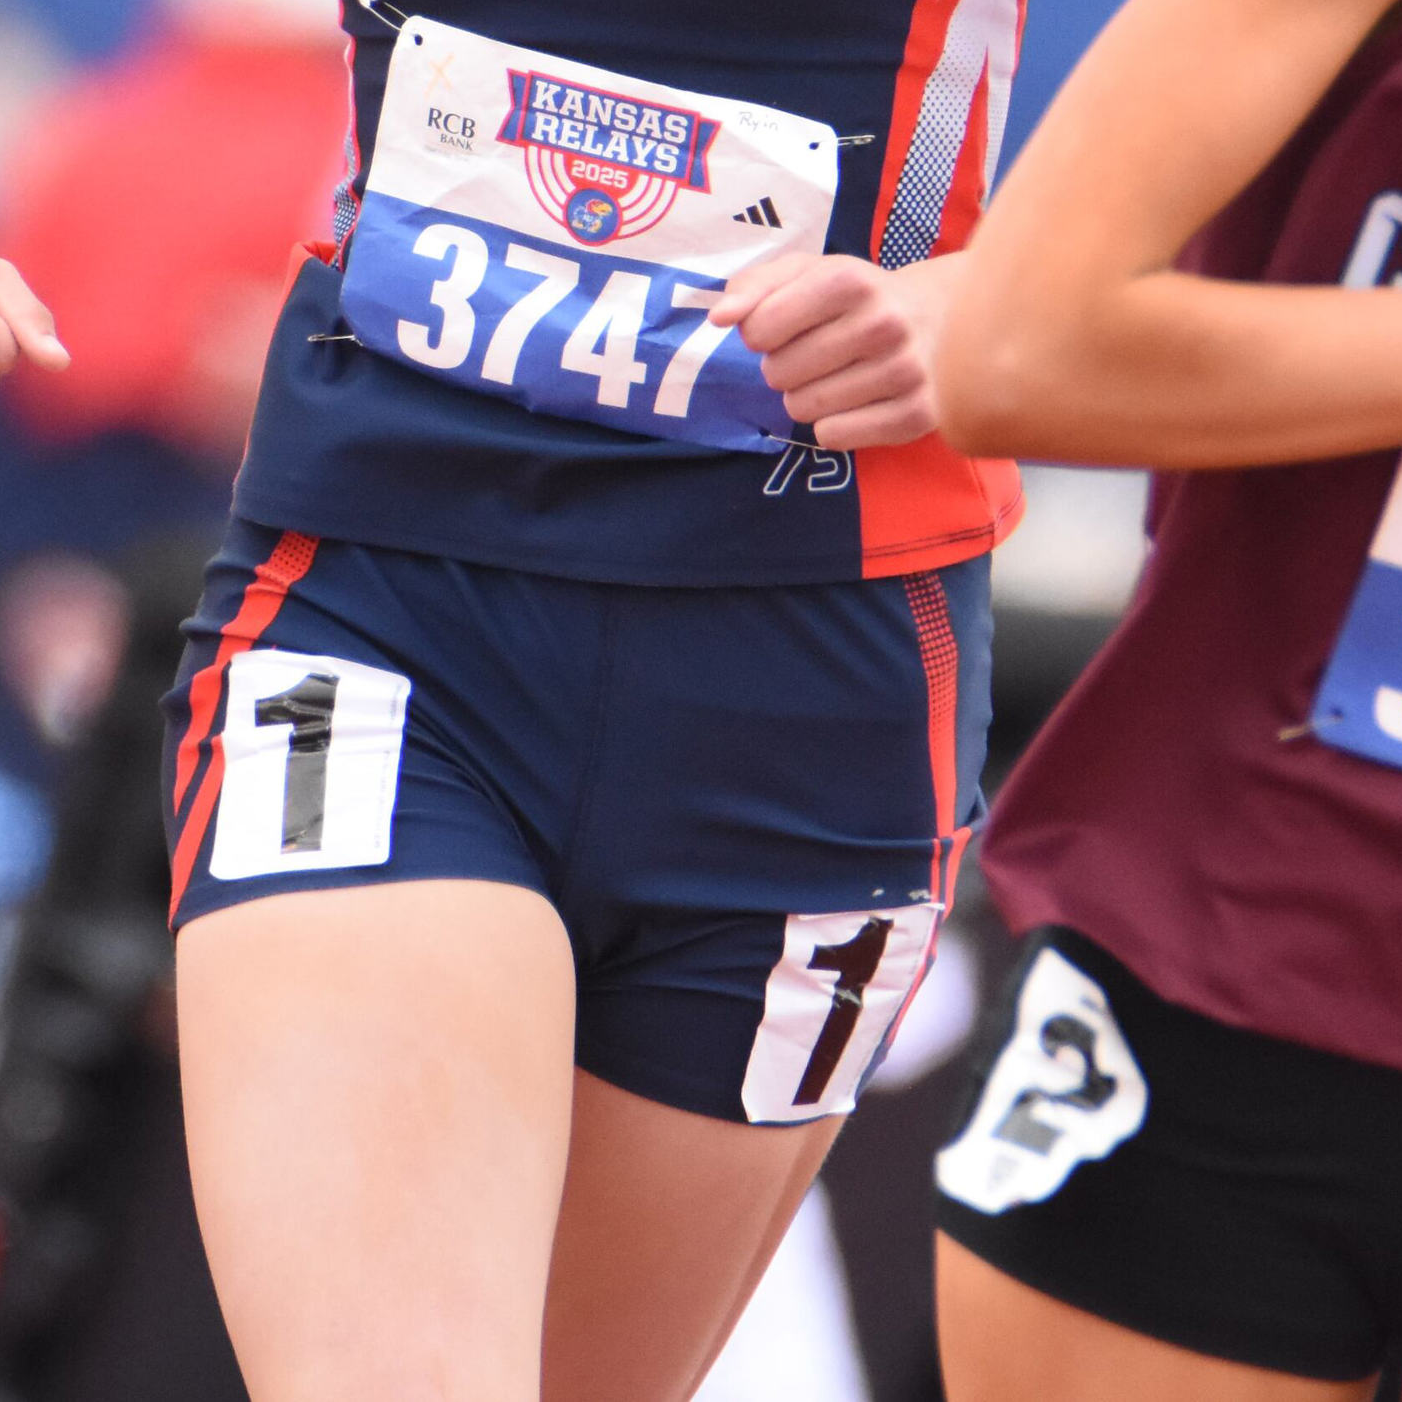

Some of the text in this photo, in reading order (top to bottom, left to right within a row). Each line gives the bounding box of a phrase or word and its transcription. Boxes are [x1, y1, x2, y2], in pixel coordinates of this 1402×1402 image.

[427, 107, 476, 139] RCB
[440, 133, 474, 152] BANK
[531, 111, 680, 173] RELAYS
[532, 80, 688, 144] KANSAS
[571, 159, 629, 189] 2025
[397, 223, 736, 419] 3747
[254, 673, 338, 852] 1
[791, 916, 894, 1106] 1
[992, 1014, 1117, 1156] 2
